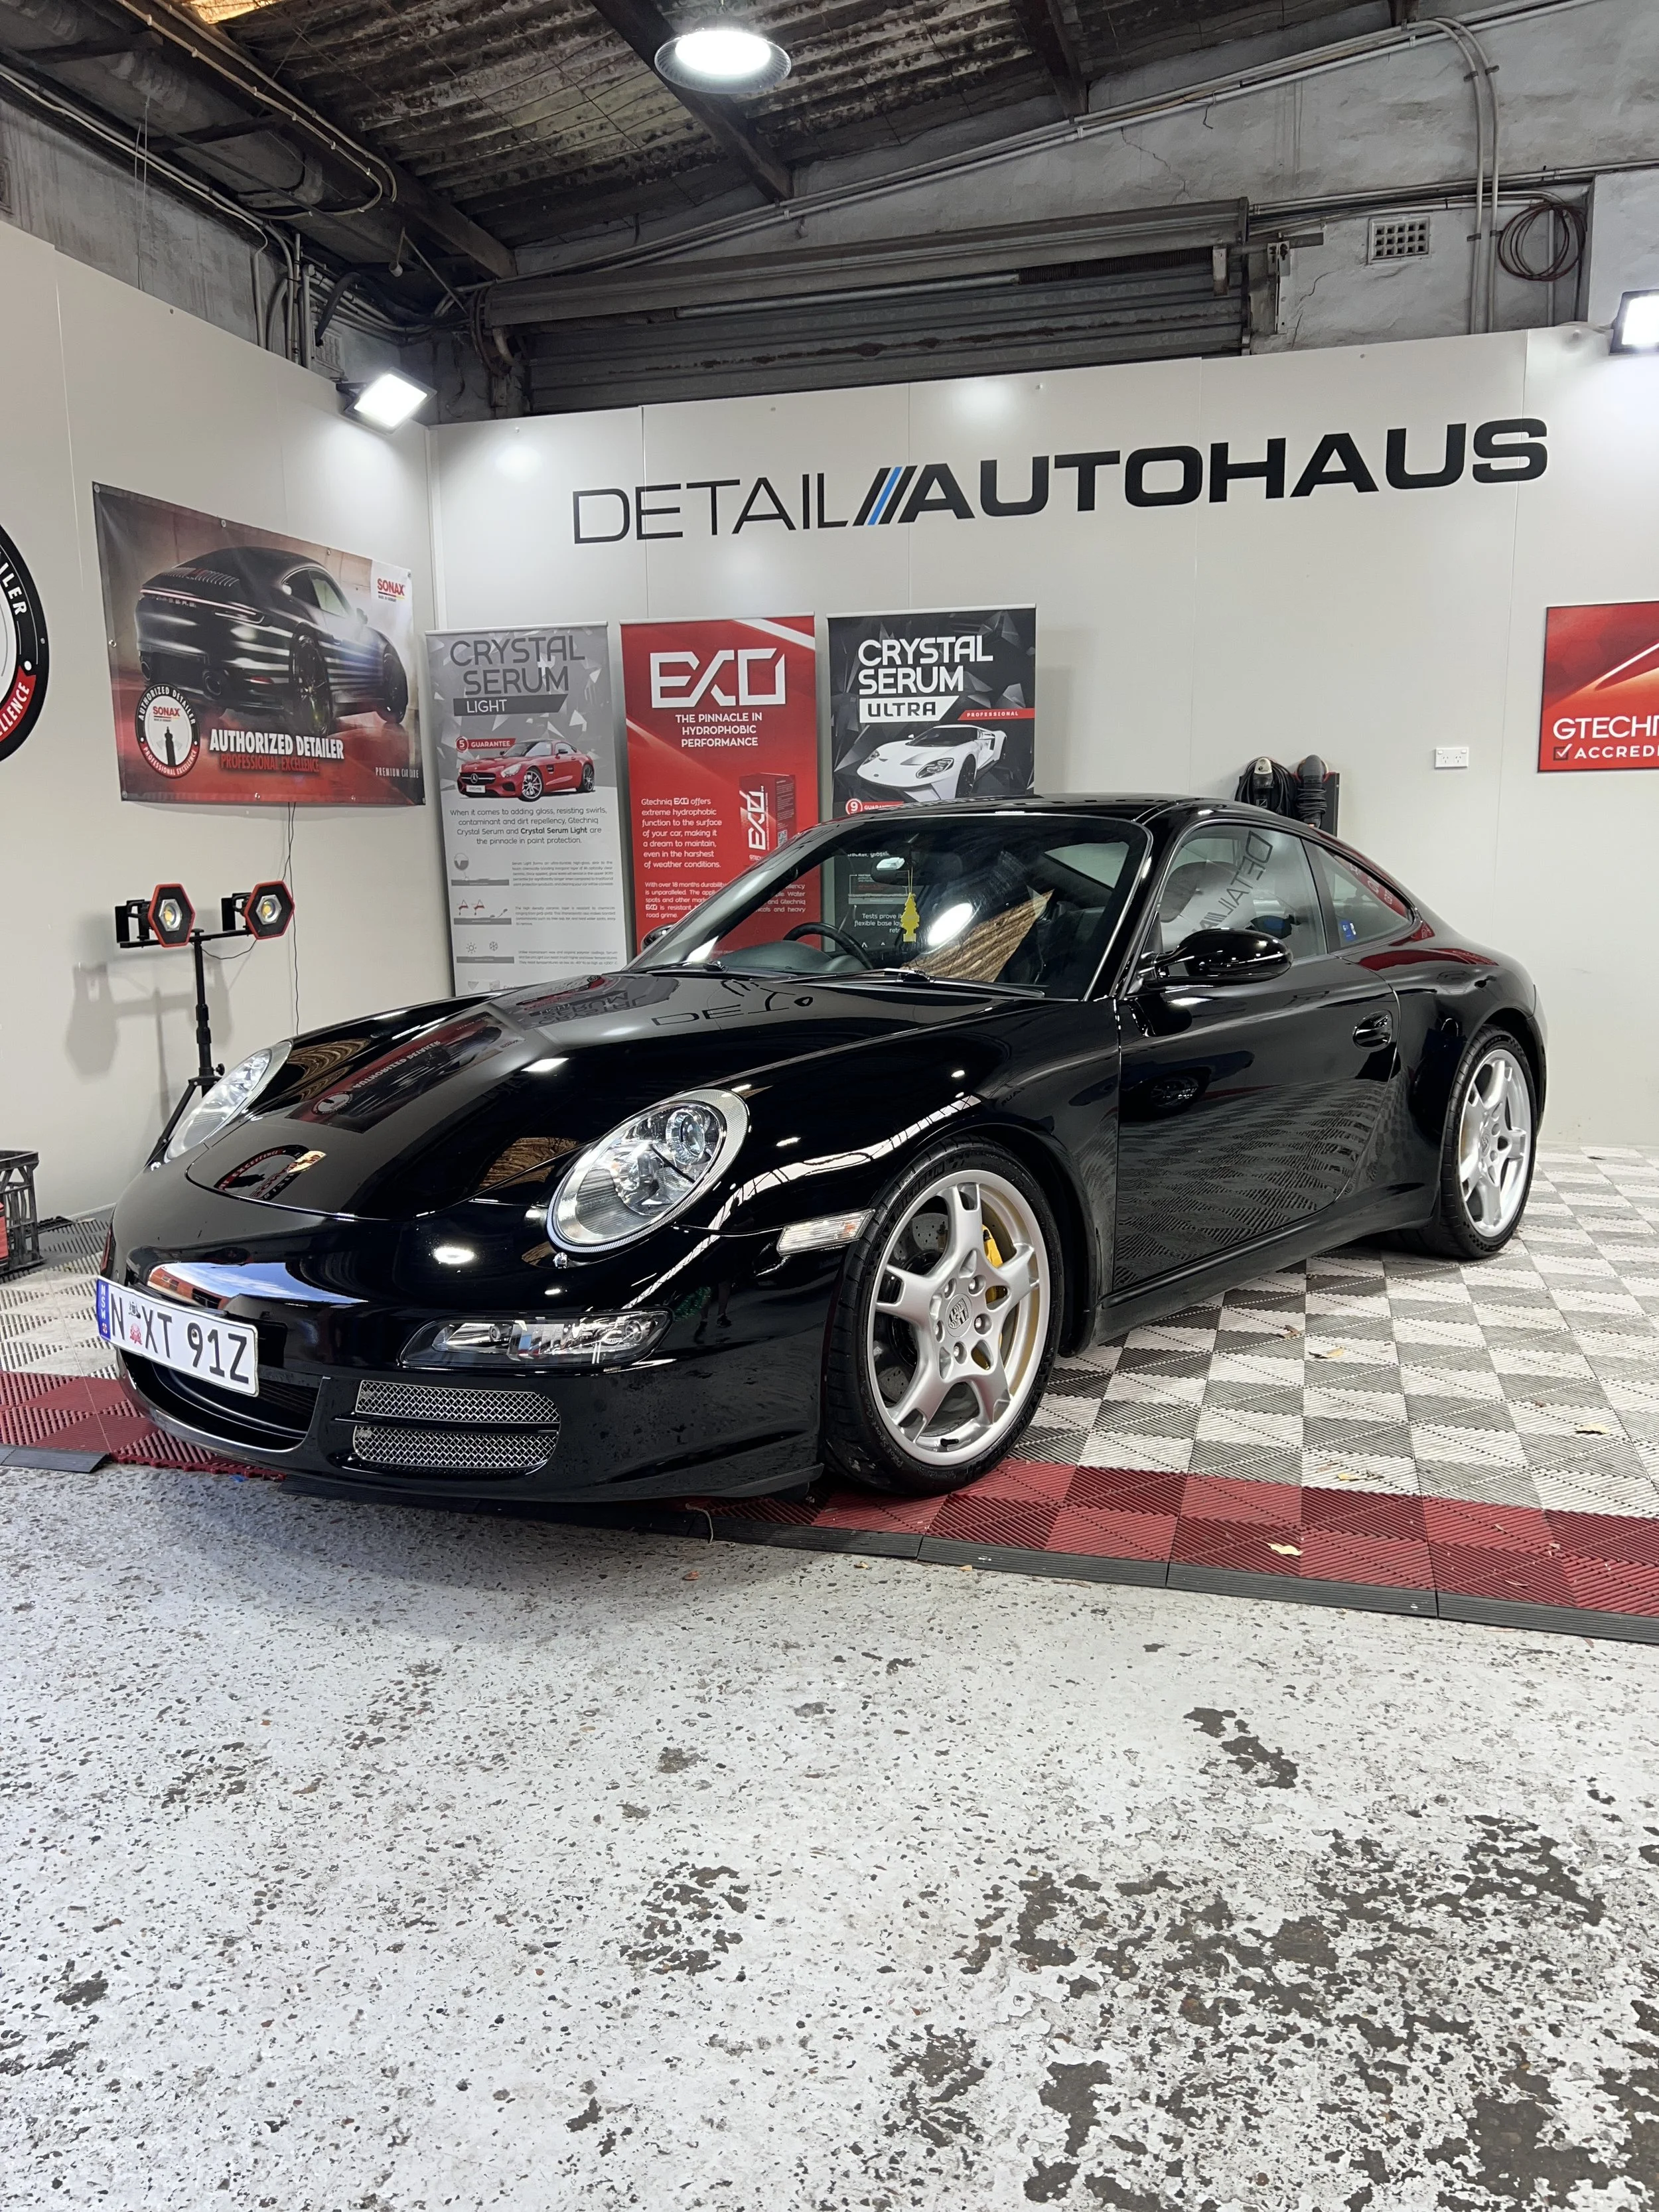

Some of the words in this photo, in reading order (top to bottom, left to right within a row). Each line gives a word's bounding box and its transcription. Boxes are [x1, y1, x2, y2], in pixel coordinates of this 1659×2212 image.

[573, 473, 848, 544] DETAIL
[898, 418, 1547, 523] AUTOHAUS
[0, 562, 27, 615] ILER
[378, 578, 404, 595] SONAX
[450, 635, 585, 666] CRYSTAL
[858, 635, 993, 666] CRYSTAL
[463, 666, 569, 696] SERUM
[650, 648, 786, 708] EXO
[858, 665, 964, 695] SERUM
[0, 682, 29, 737] LLENCE
[138, 686, 170, 721] AUTHORIZED
[173, 690, 196, 724] DETAILER
[153, 706, 180, 717] SONAX
[467, 699, 507, 713] LIGHT
[867, 701, 936, 717] ULTRA
[676, 714, 695, 723] THE
[699, 713, 749, 723] PINNACLE
[751, 712, 762, 721] IN
[682, 725, 757, 735] HYDROPHOBIC
[210, 729, 293, 755] AUTHORIZED
[296, 735, 344, 759] DETAILER
[682, 737, 758, 747] PERFORMANCE
[143, 747, 175, 775] PROFESSIONAL
[177, 749, 197, 775] EXCELLENCE
[220, 754, 278, 771] PROFESSIONAL
[281, 756, 319, 772] EXCELLENCE
[375, 767, 399, 776] PREMIUM
[536, 808, 555, 816] gloss,
[557, 807, 584, 816] resisting
[672, 808, 717, 817] hydrophobic
[850, 802, 858, 811] 9
[520, 827, 545, 836] Crystal
[642, 819, 670, 828] function
[547, 836, 582, 845] protection.
[187, 1322, 250, 1384] 91Z
